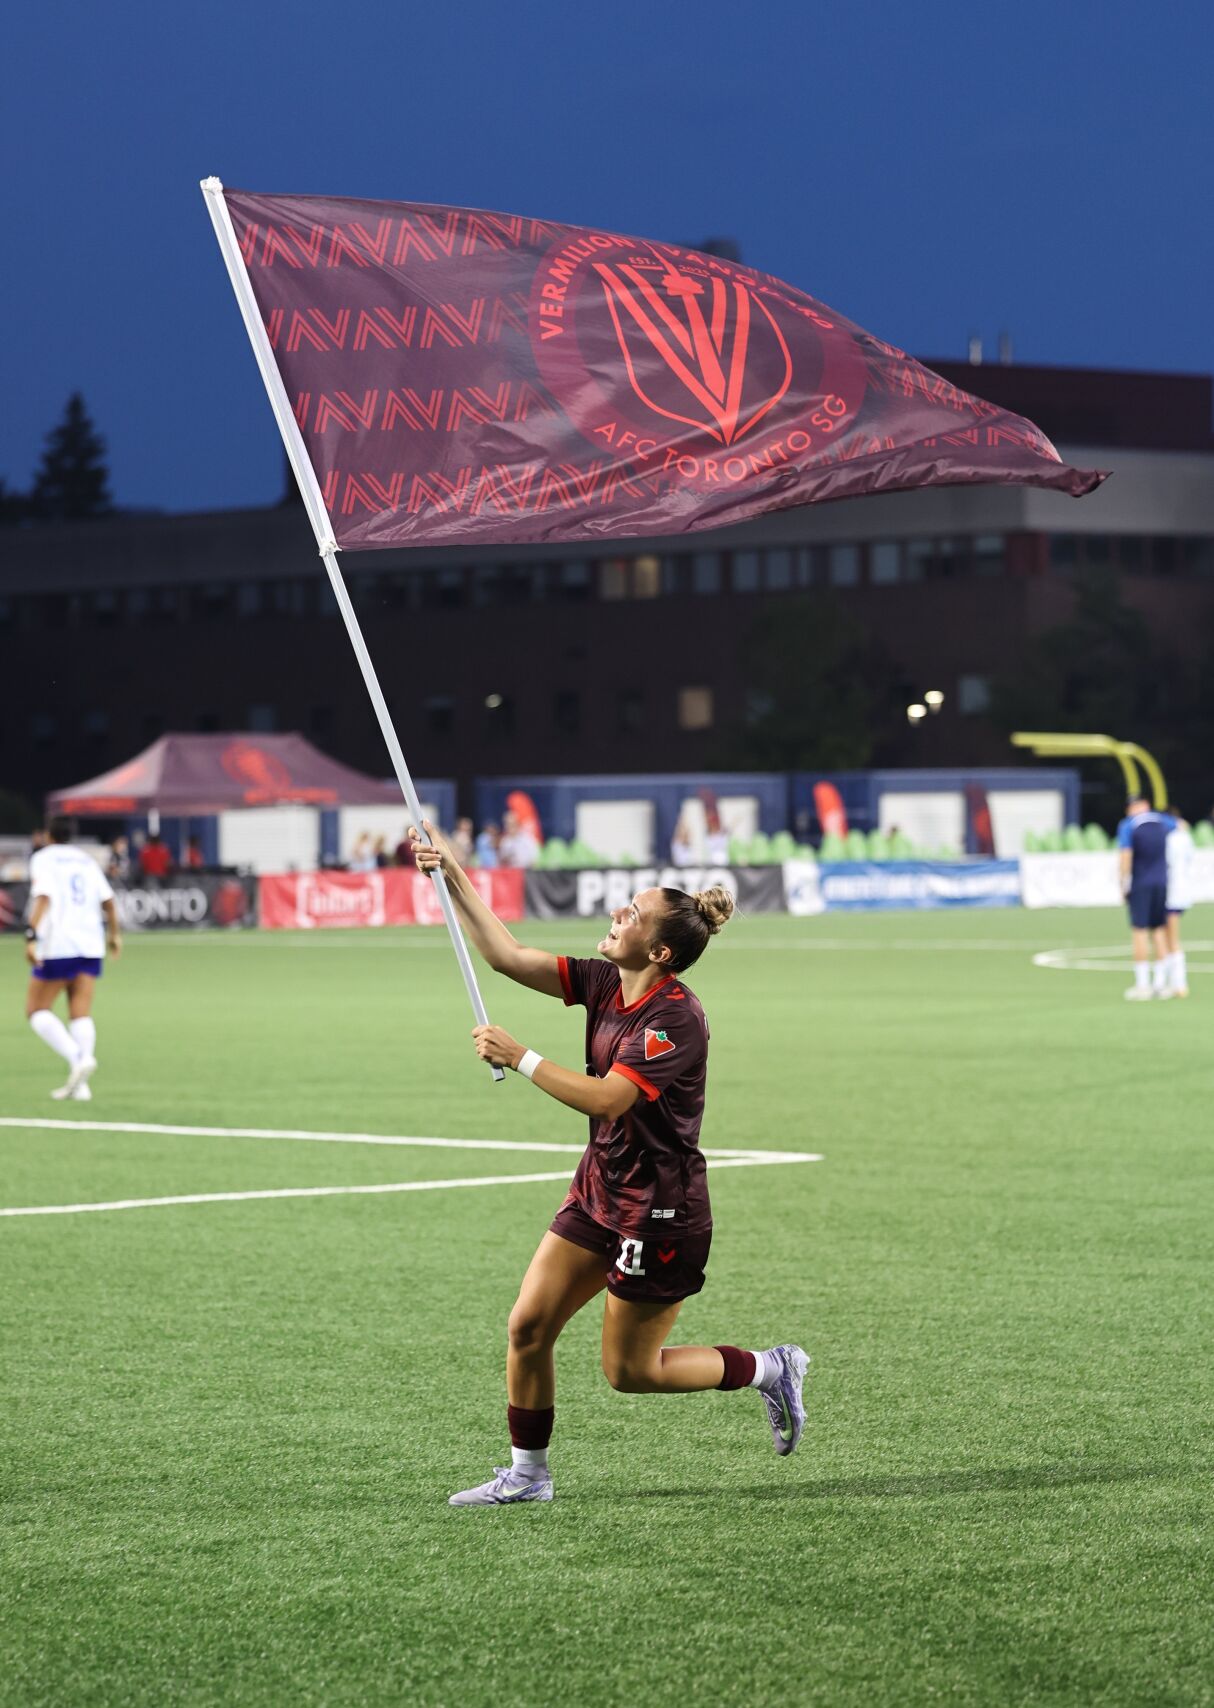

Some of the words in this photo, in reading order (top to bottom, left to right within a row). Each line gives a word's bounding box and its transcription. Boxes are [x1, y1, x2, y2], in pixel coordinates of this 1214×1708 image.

[539, 235, 637, 341] VERMILION
[627, 256, 656, 265] EST.
[594, 422, 656, 461] AFC
[661, 430, 812, 482] TORONTO
[811, 394, 847, 433] SG
